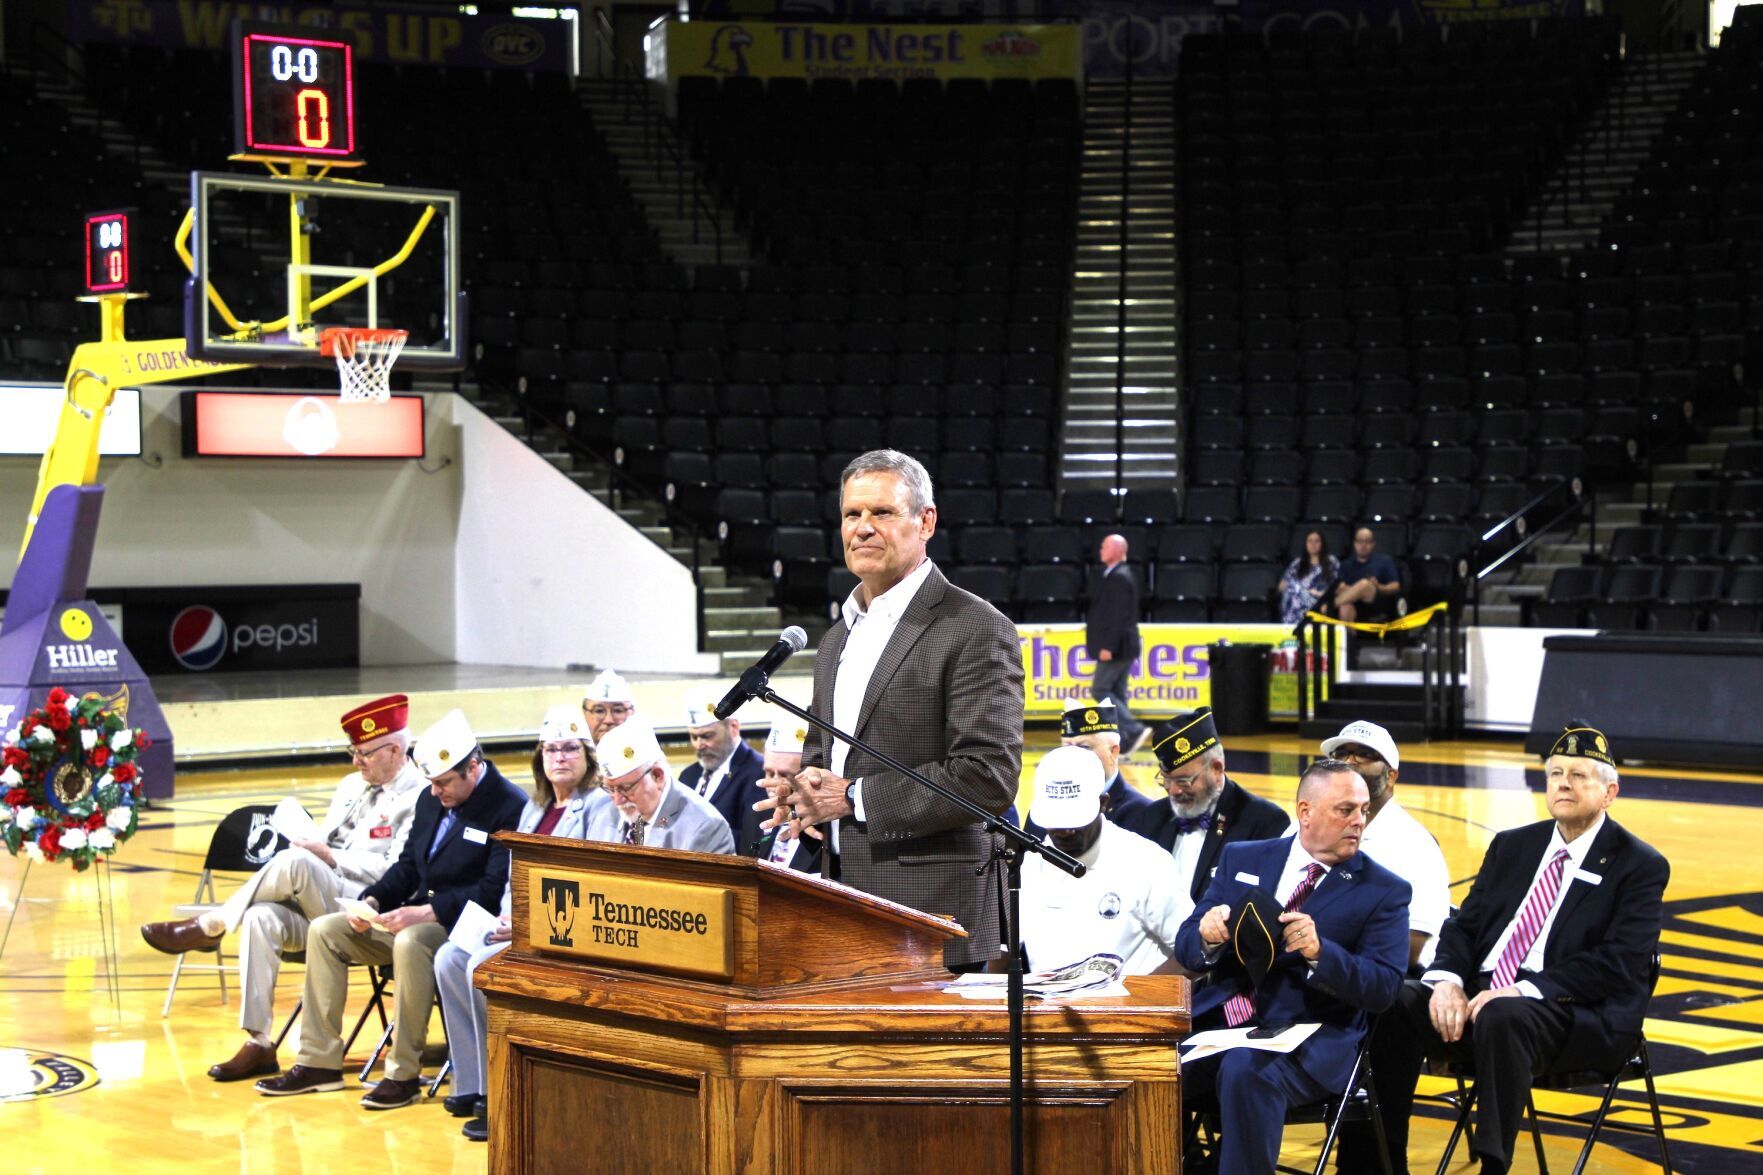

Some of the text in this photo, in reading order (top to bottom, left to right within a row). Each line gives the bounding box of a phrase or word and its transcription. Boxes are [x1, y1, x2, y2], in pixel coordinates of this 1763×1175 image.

[386, 14, 463, 65] UP
[775, 26, 855, 62] The
[866, 27, 966, 64] Nest
[805, 65, 868, 79] Student
[136, 350, 189, 372] GOLDEN
[233, 618, 318, 653] pepsi
[46, 644, 118, 668] Hiller
[1019, 637, 1096, 681] he
[1034, 684, 1094, 701] Stude
[1060, 784, 1081, 795] STATE
[589, 892, 708, 936] Tennessee
[592, 924, 640, 948] TECH
